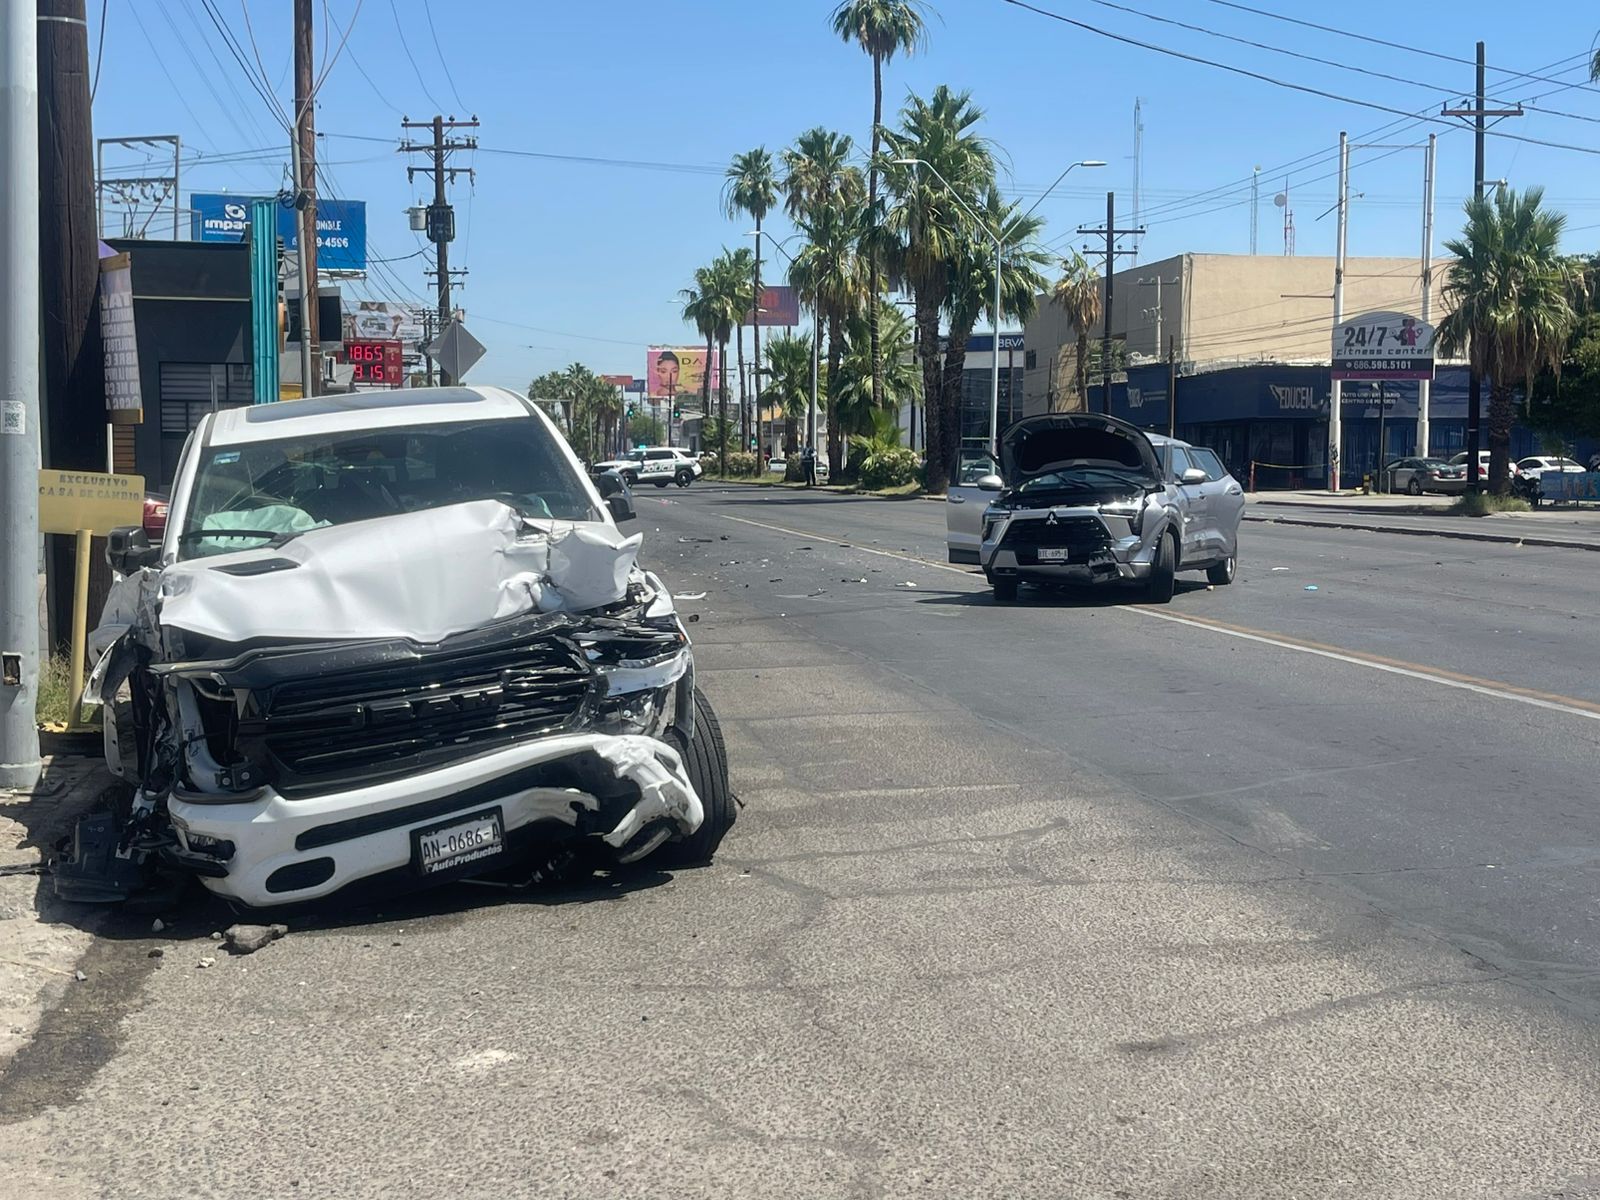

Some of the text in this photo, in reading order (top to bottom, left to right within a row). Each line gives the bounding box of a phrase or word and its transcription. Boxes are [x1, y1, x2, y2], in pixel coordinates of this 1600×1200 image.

[316, 220, 341, 231] ONIBLE
[316, 236, 348, 248] 9-4596
[1344, 325, 1388, 347] 24/7
[1388, 347, 1432, 355] center
[642, 463, 676, 473] POLICIA
[59, 474, 128, 486] EXCLUSIVO
[39, 486, 140, 501] CASA DE CAMBIO
[422, 822, 501, 860] AN-0686-A
[431, 844, 503, 873] AutoProductos
